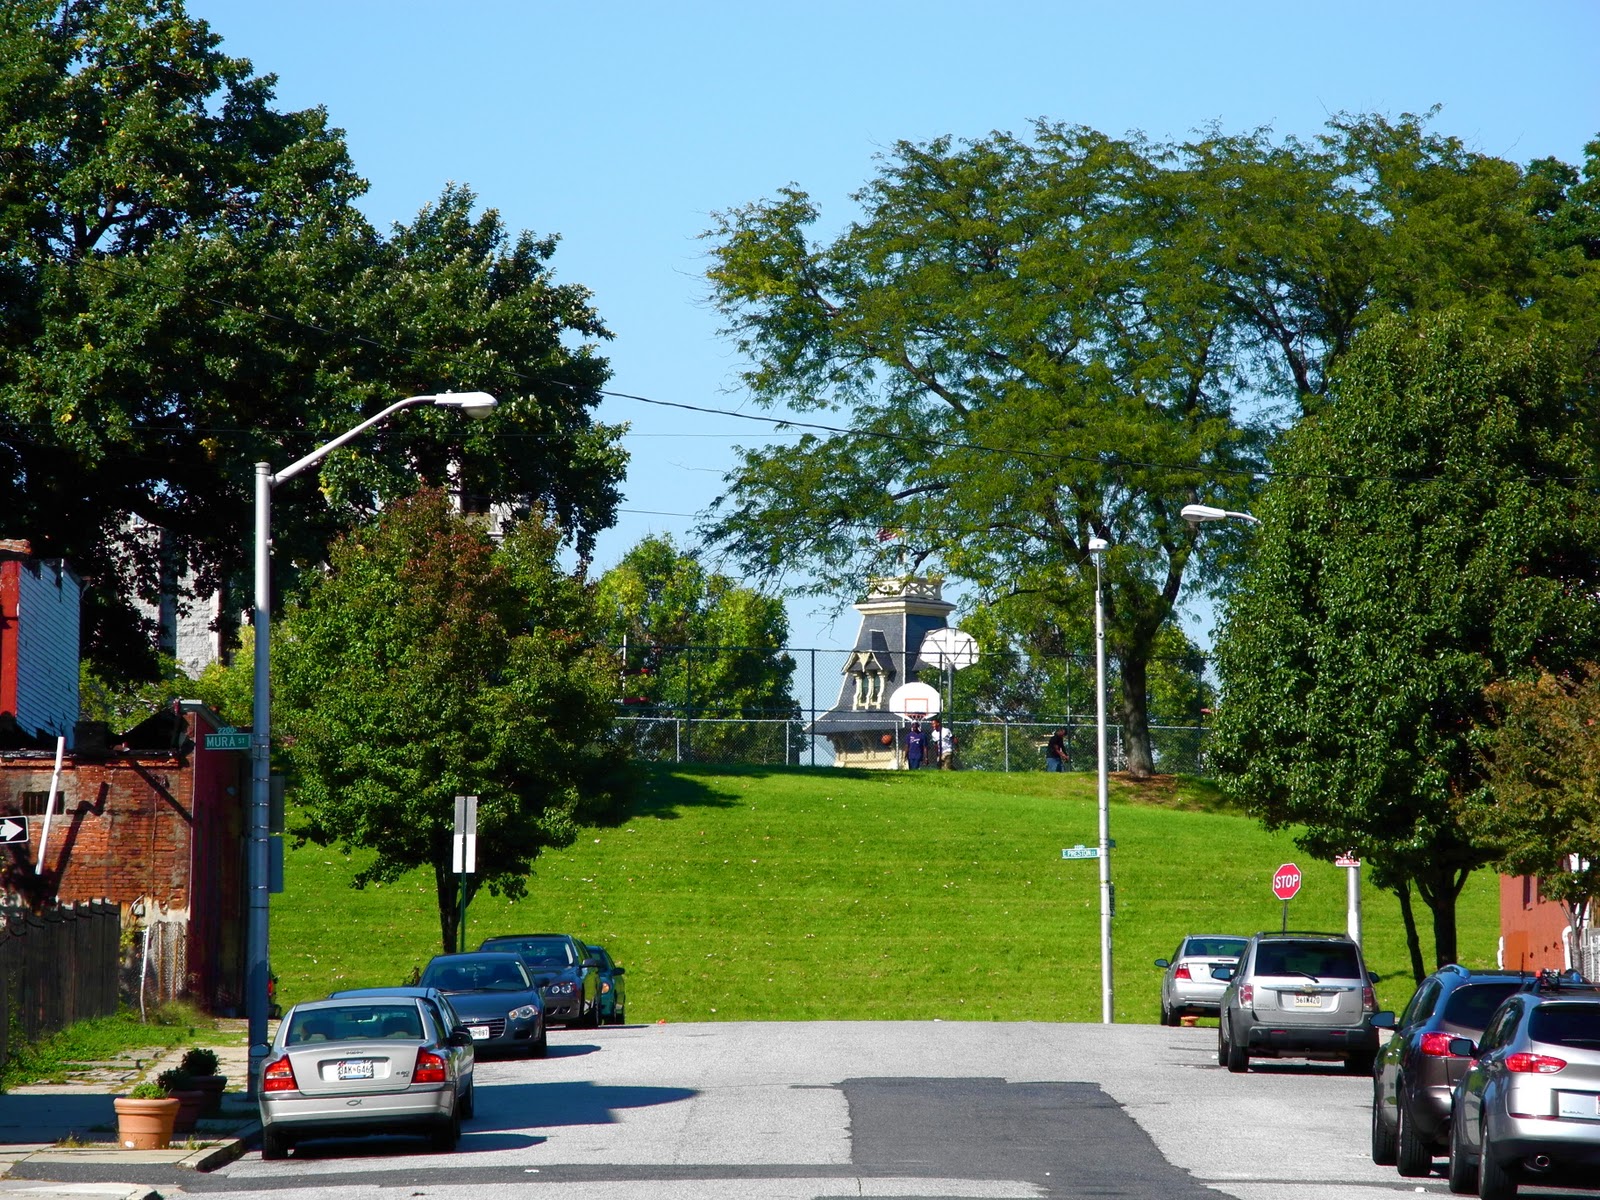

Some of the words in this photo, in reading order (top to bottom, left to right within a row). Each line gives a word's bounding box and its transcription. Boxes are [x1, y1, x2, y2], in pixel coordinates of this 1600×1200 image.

[206, 736, 236, 747] MURA
[1067, 849, 1092, 857] PRESTON
[1275, 874, 1299, 889] STOP
